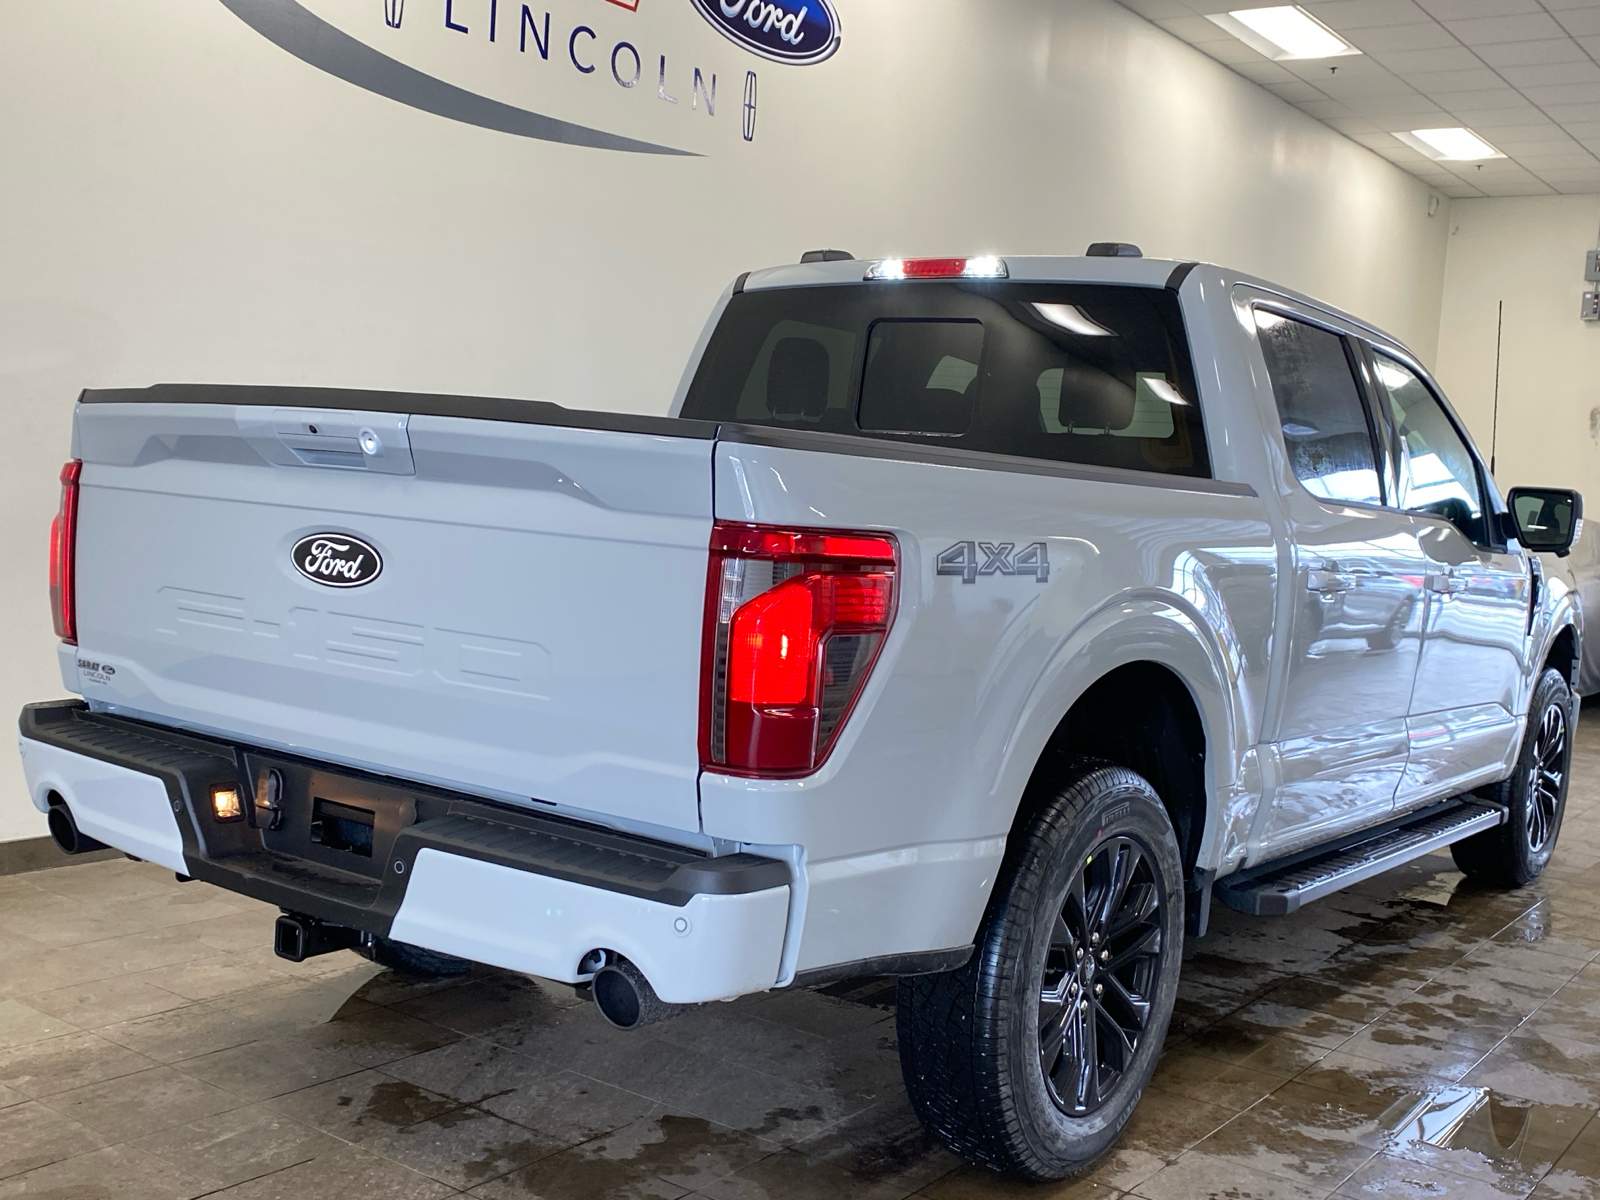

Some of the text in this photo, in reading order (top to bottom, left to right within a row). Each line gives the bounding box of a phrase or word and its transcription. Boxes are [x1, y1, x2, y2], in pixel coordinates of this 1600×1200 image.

[445, 0, 717, 116] LINCOLN
[305, 540, 364, 579] Ford
[83, 670, 111, 682] LINCOLN
